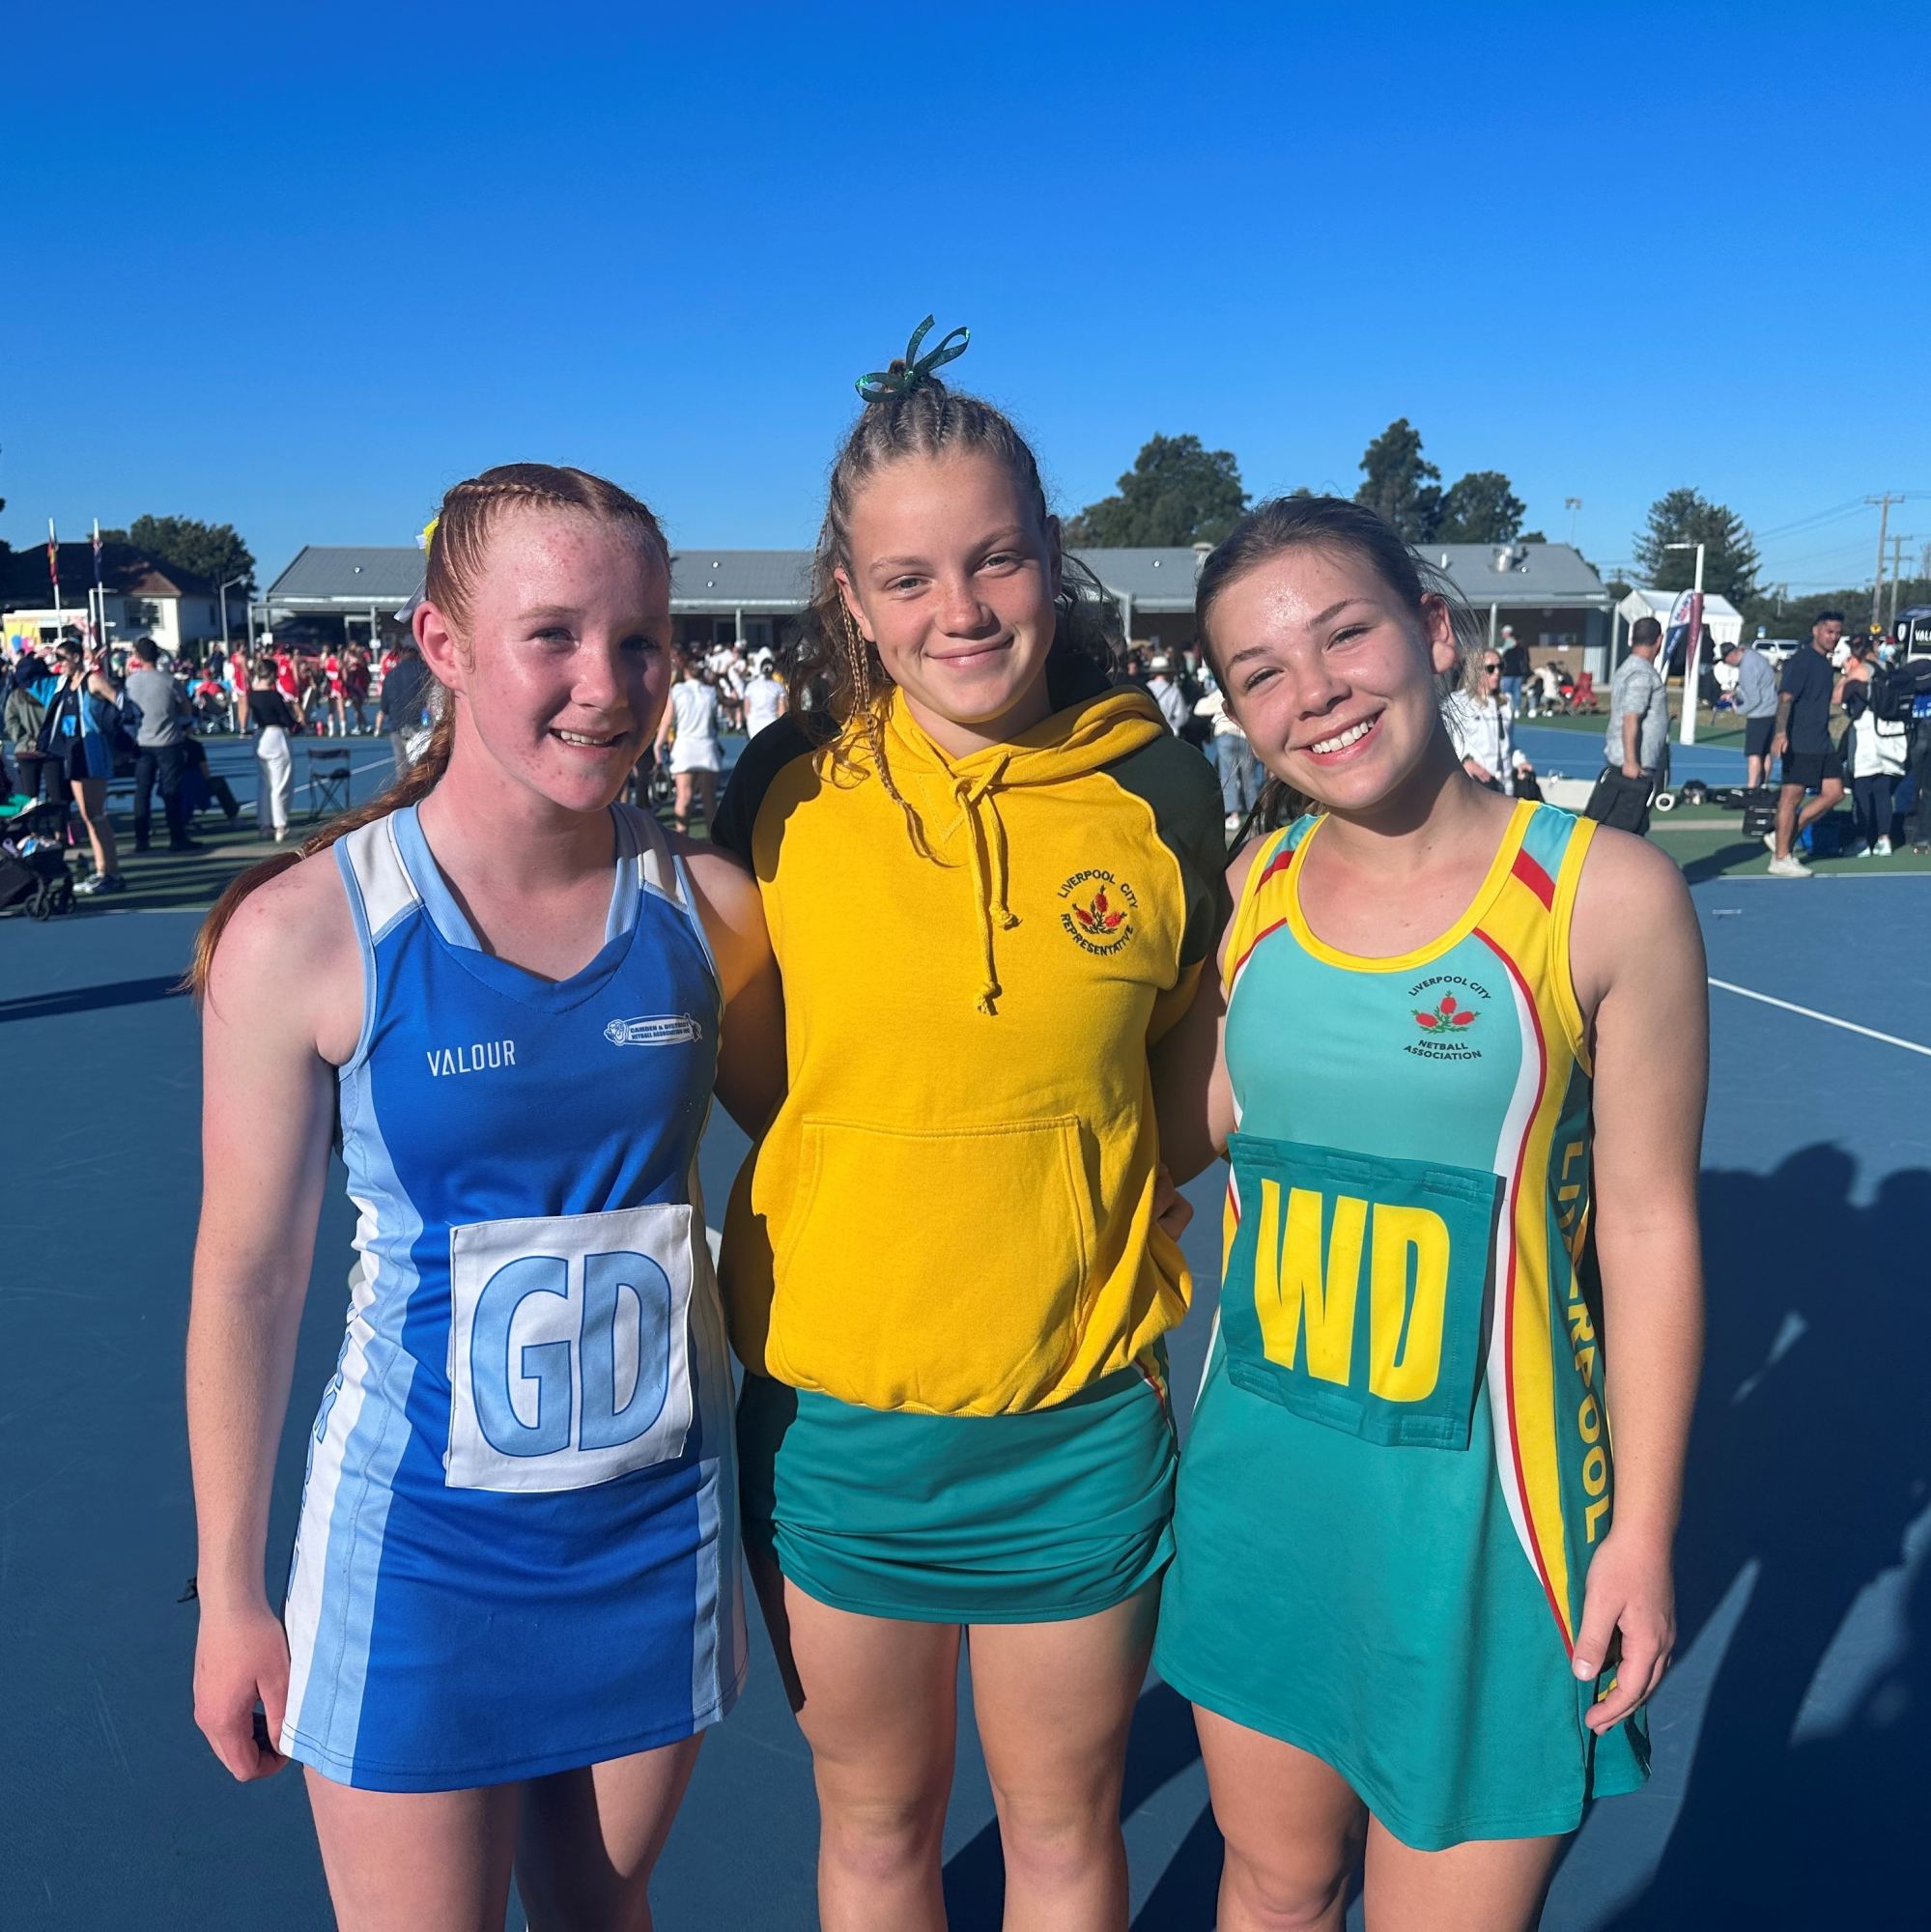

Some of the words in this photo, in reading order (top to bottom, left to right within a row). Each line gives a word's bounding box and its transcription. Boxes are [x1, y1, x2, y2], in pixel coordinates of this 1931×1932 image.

[1915, 629, 1931, 642] VAL
[1058, 869, 1116, 898] LIVERPOOL
[1121, 883, 1138, 909] CITY
[1061, 913, 1134, 956] REPRESENTATIVE
[1408, 976, 1467, 996] LIVERPOOL
[1469, 982, 1491, 1000] CITY
[426, 1039, 516, 1077] VALOUR
[1404, 1045, 1482, 1061] ASSOCIATION
[1418, 1039, 1468, 1050] NETBALL
[1254, 1178, 1451, 1403] WD
[470, 1250, 671, 1458] GD
[1557, 1141, 1609, 1544] LIRPOOL
